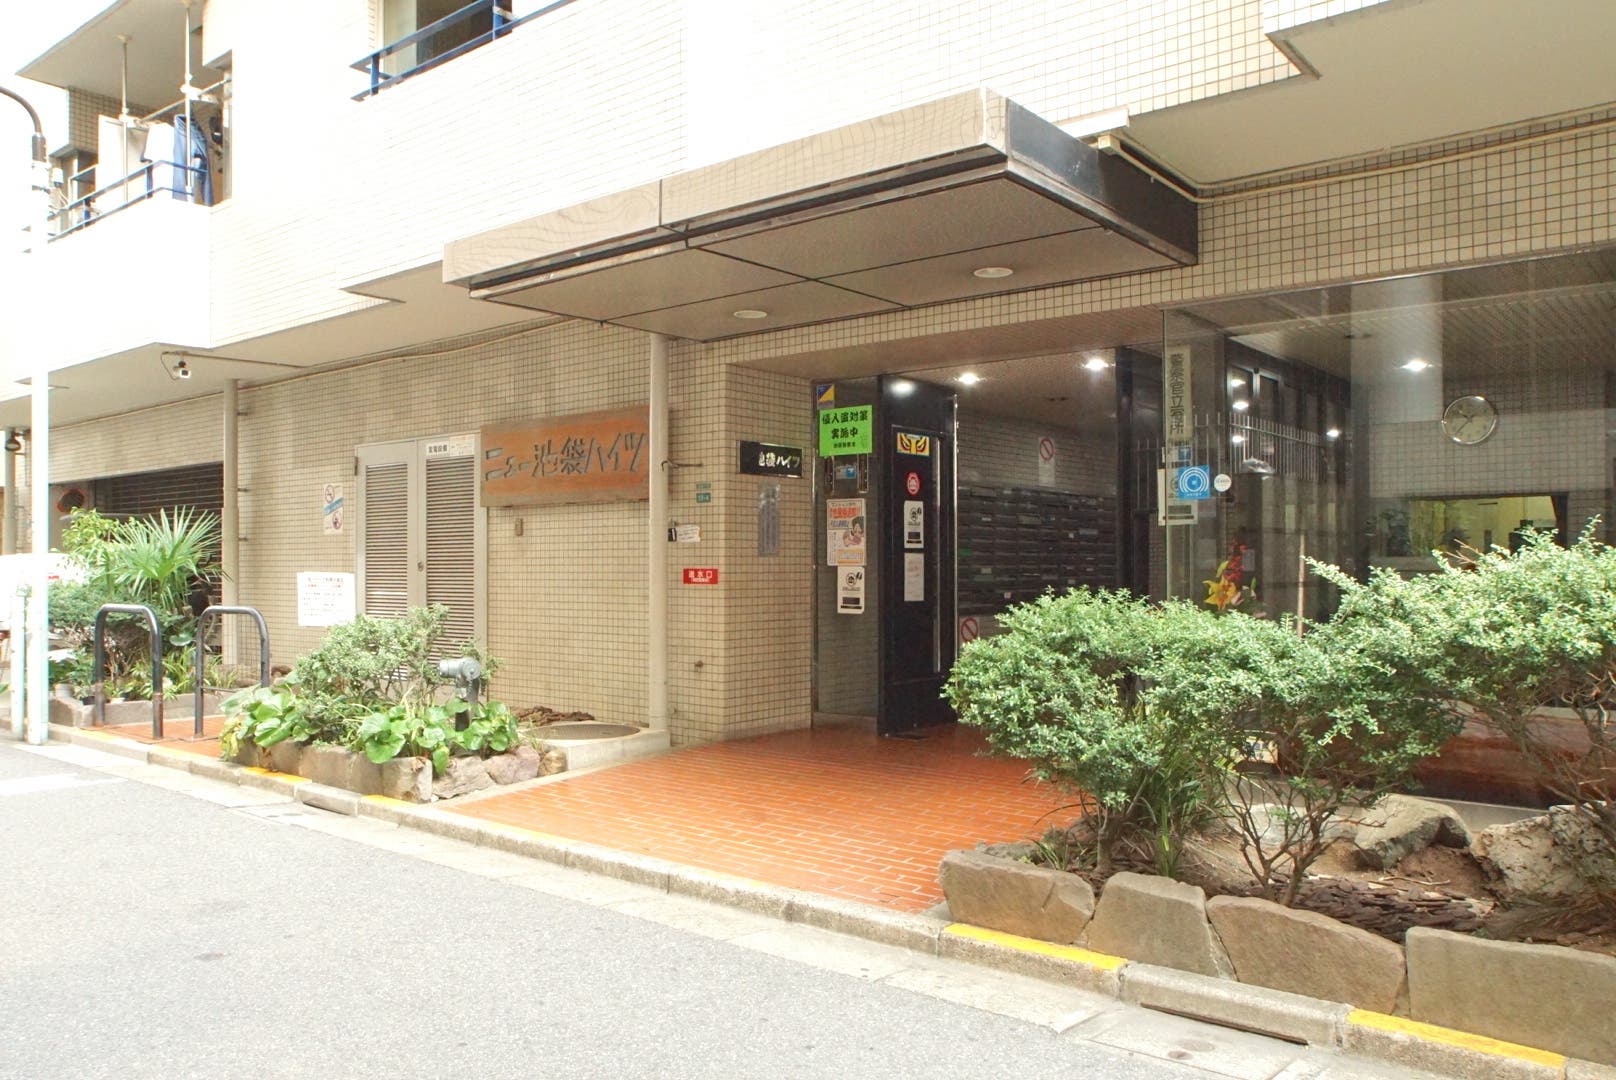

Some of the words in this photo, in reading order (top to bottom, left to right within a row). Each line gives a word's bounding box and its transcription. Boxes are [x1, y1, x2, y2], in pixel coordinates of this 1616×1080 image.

[831, 426, 858, 440] 実施中
[485, 431, 648, 480] ニュー池袋ハイツ
